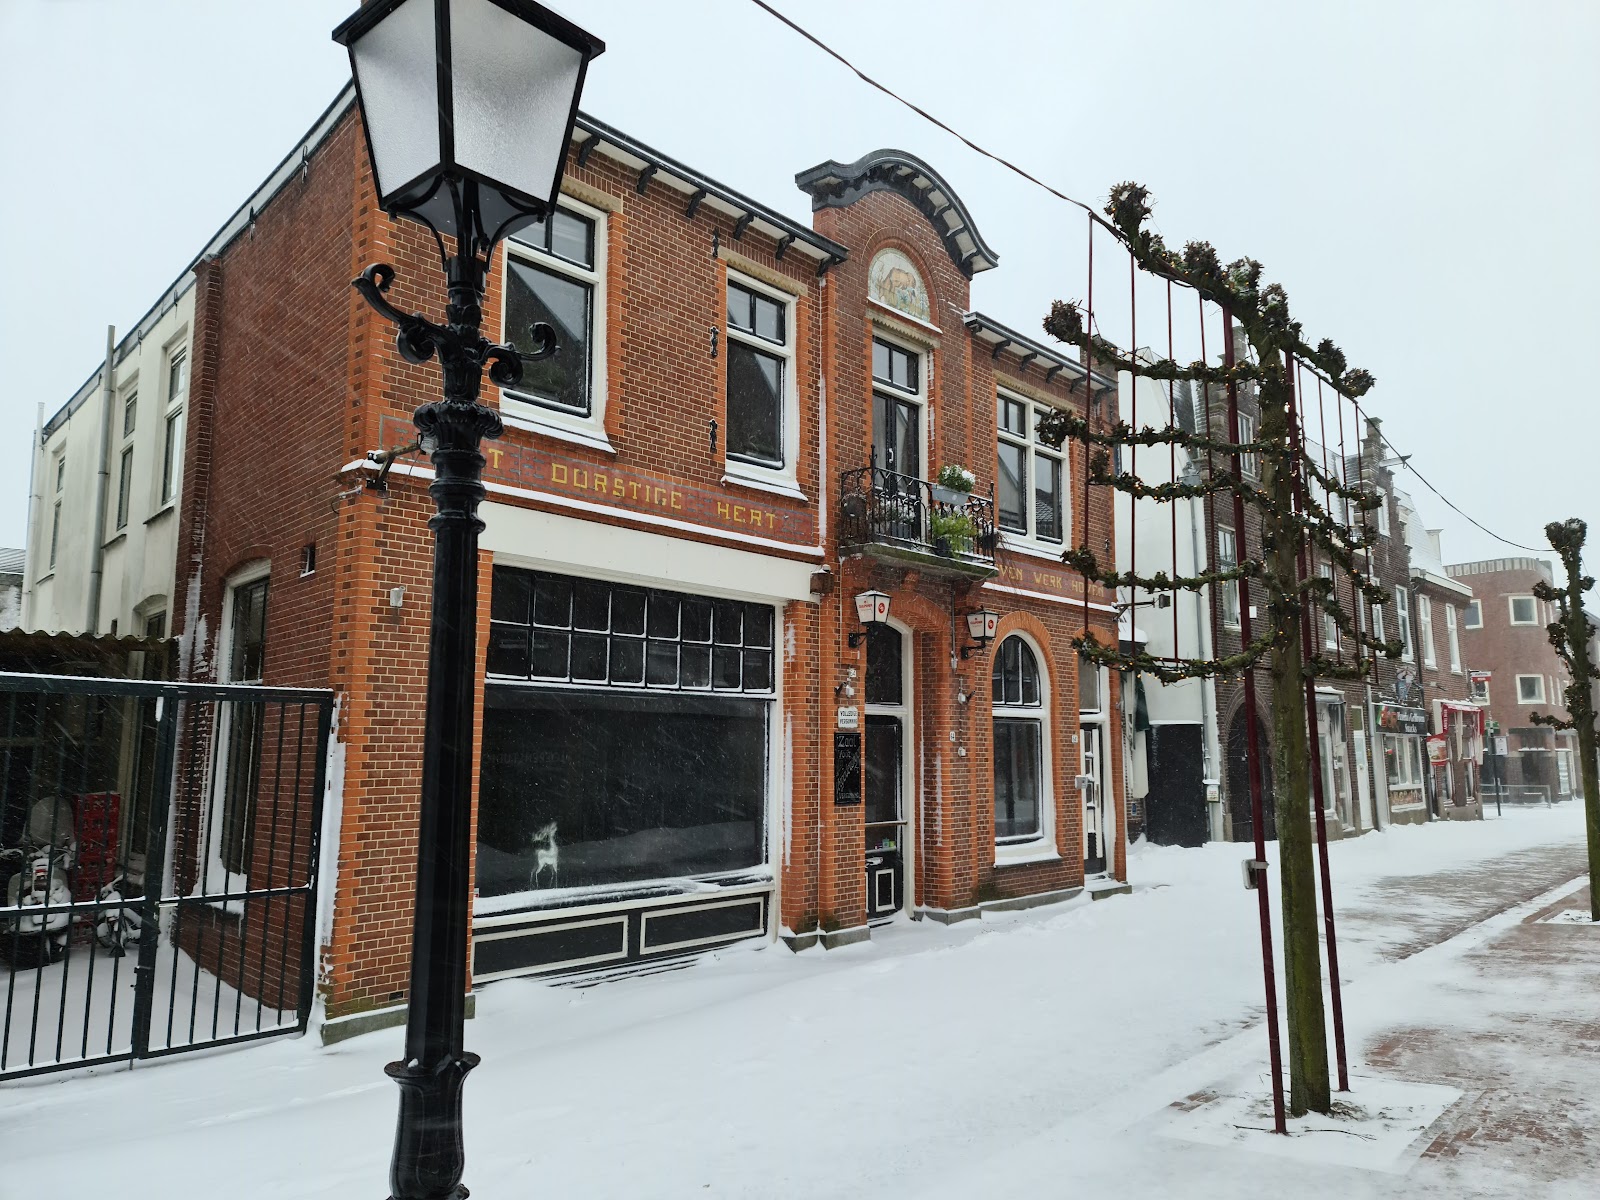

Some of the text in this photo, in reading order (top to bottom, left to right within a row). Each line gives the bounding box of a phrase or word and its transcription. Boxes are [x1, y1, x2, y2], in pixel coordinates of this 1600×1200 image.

[551, 462, 682, 510] DORSTIGE
[717, 502, 776, 529] HERT
[997, 564, 1023, 581] VEN
[1033, 571, 1062, 589] WERK
